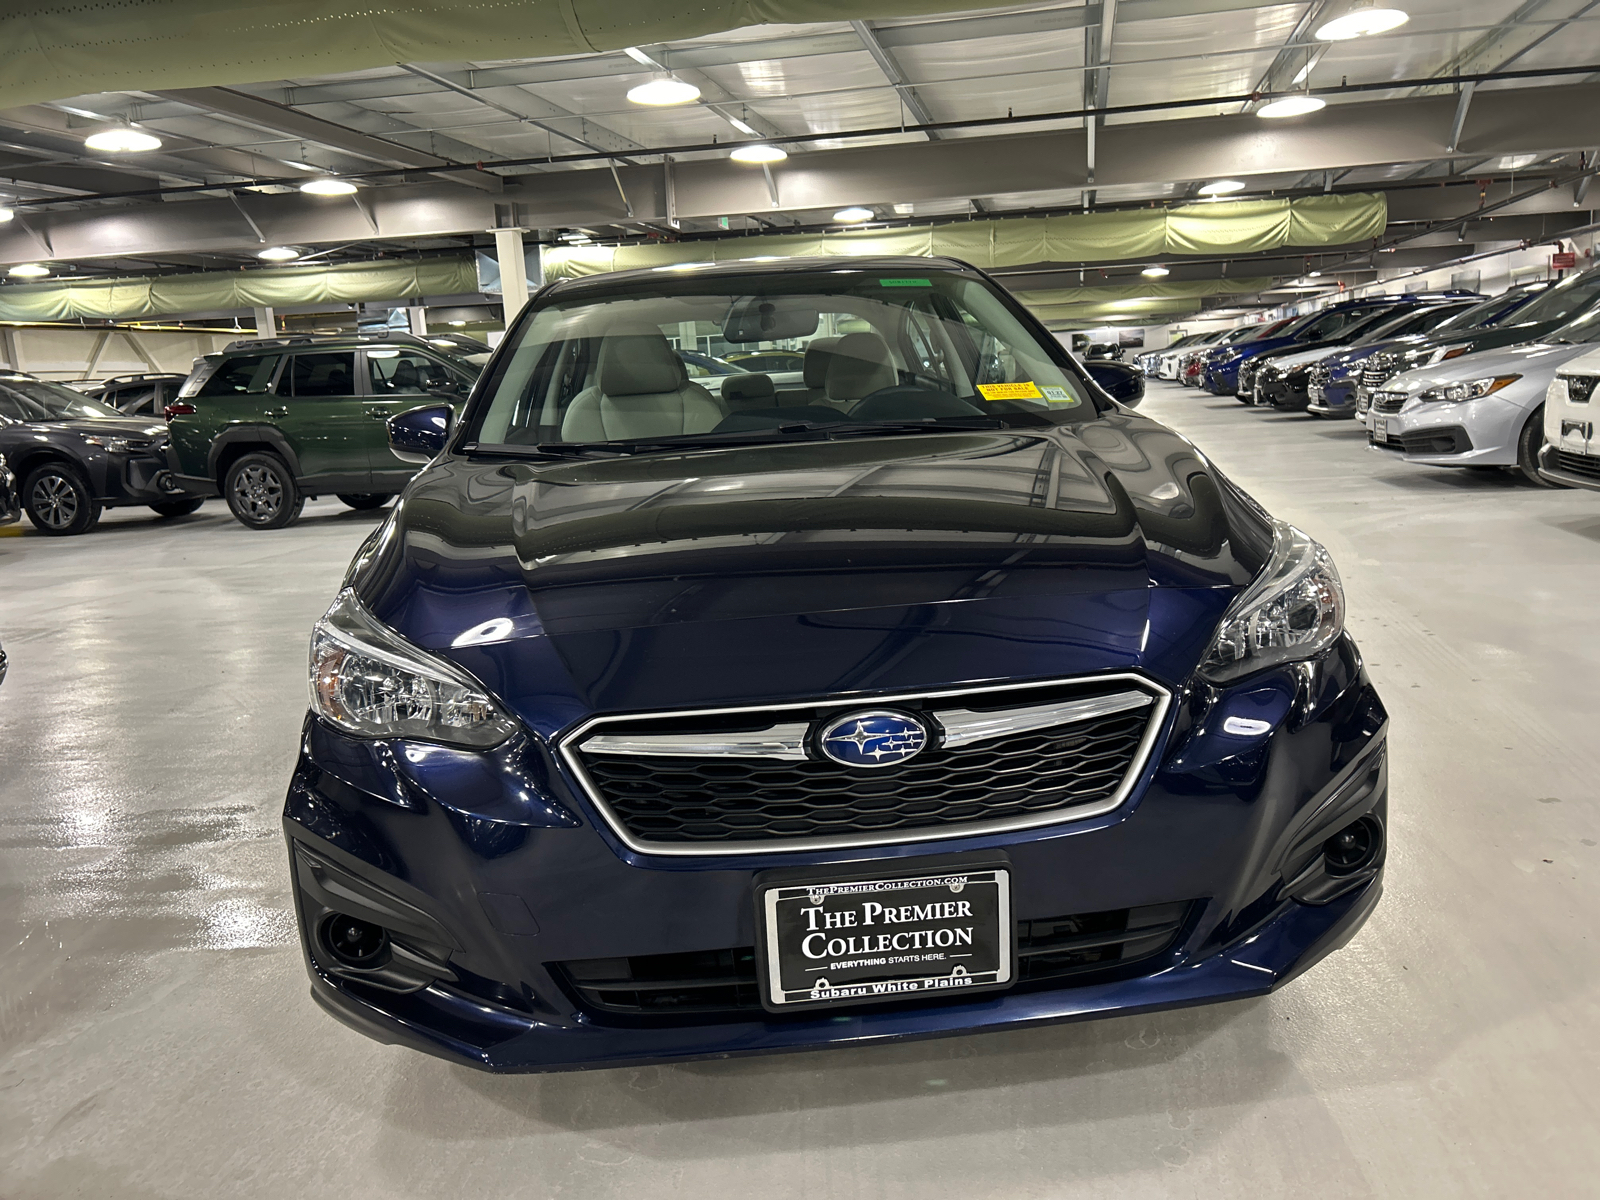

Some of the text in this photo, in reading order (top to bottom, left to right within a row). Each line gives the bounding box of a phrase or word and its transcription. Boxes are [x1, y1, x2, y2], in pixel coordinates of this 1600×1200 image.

[800, 901, 973, 931] THE PREMIER
[801, 927, 973, 959] COLLECTION
[830, 952, 947, 970] EVERYTHING STARTS HERE.
[810, 976, 973, 1000] Subaru White Plains
